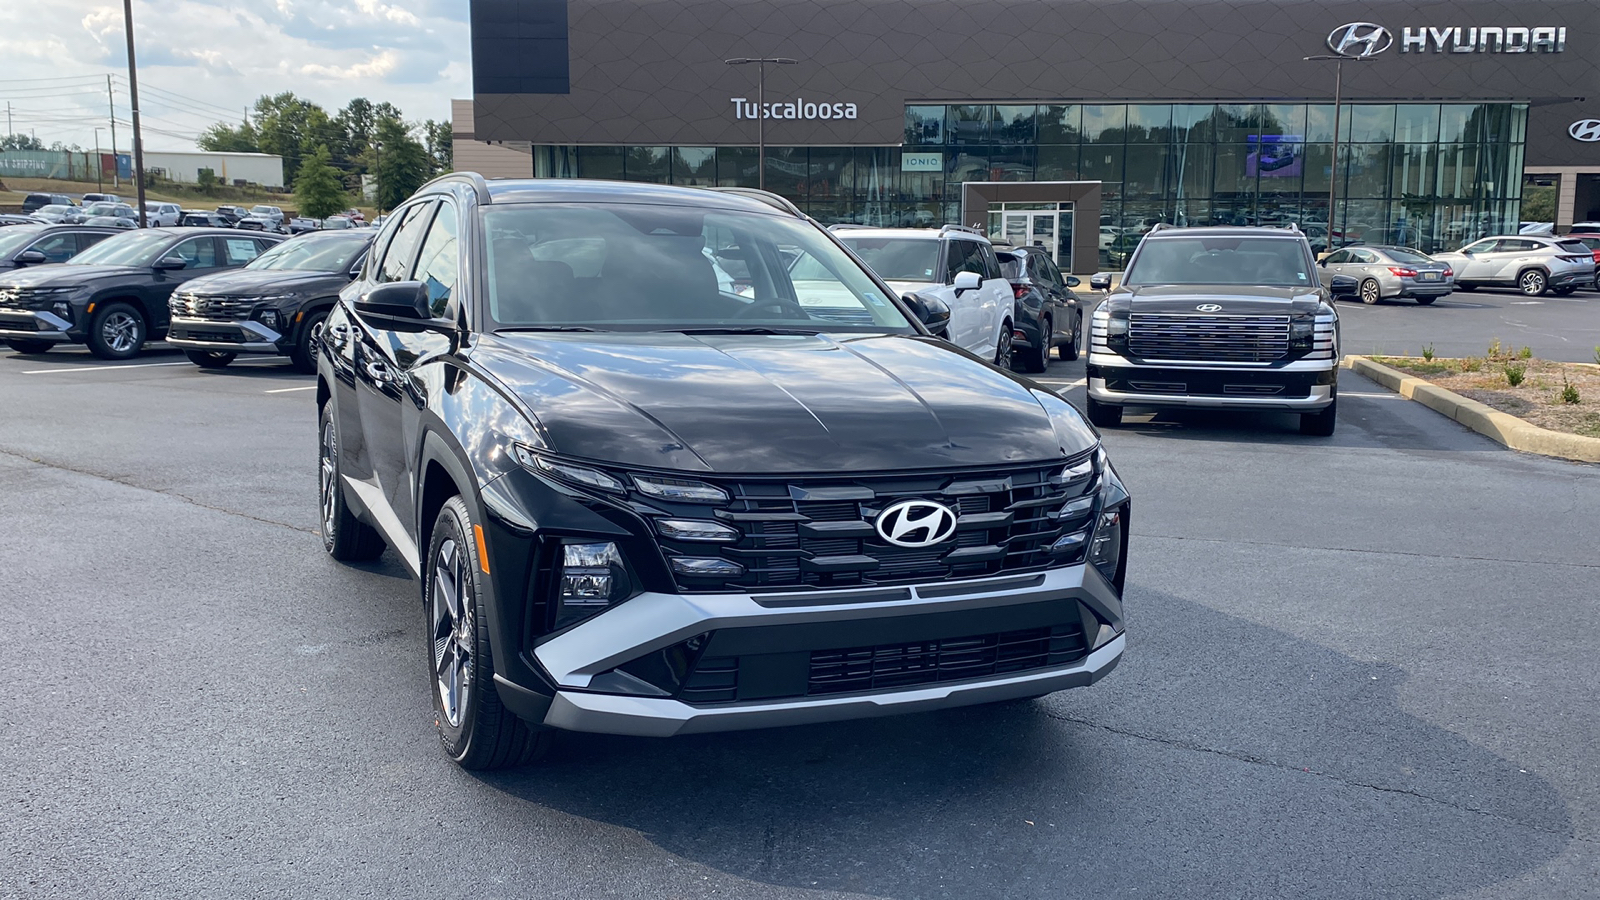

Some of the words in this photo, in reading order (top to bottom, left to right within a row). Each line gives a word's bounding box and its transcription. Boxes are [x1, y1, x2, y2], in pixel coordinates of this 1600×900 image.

[1402, 26, 1567, 53] HYUNDAI
[730, 97, 858, 119] Tuscaloosa
[12, 159, 46, 170] SHIPPING
[906, 158, 938, 166] IONIQ
